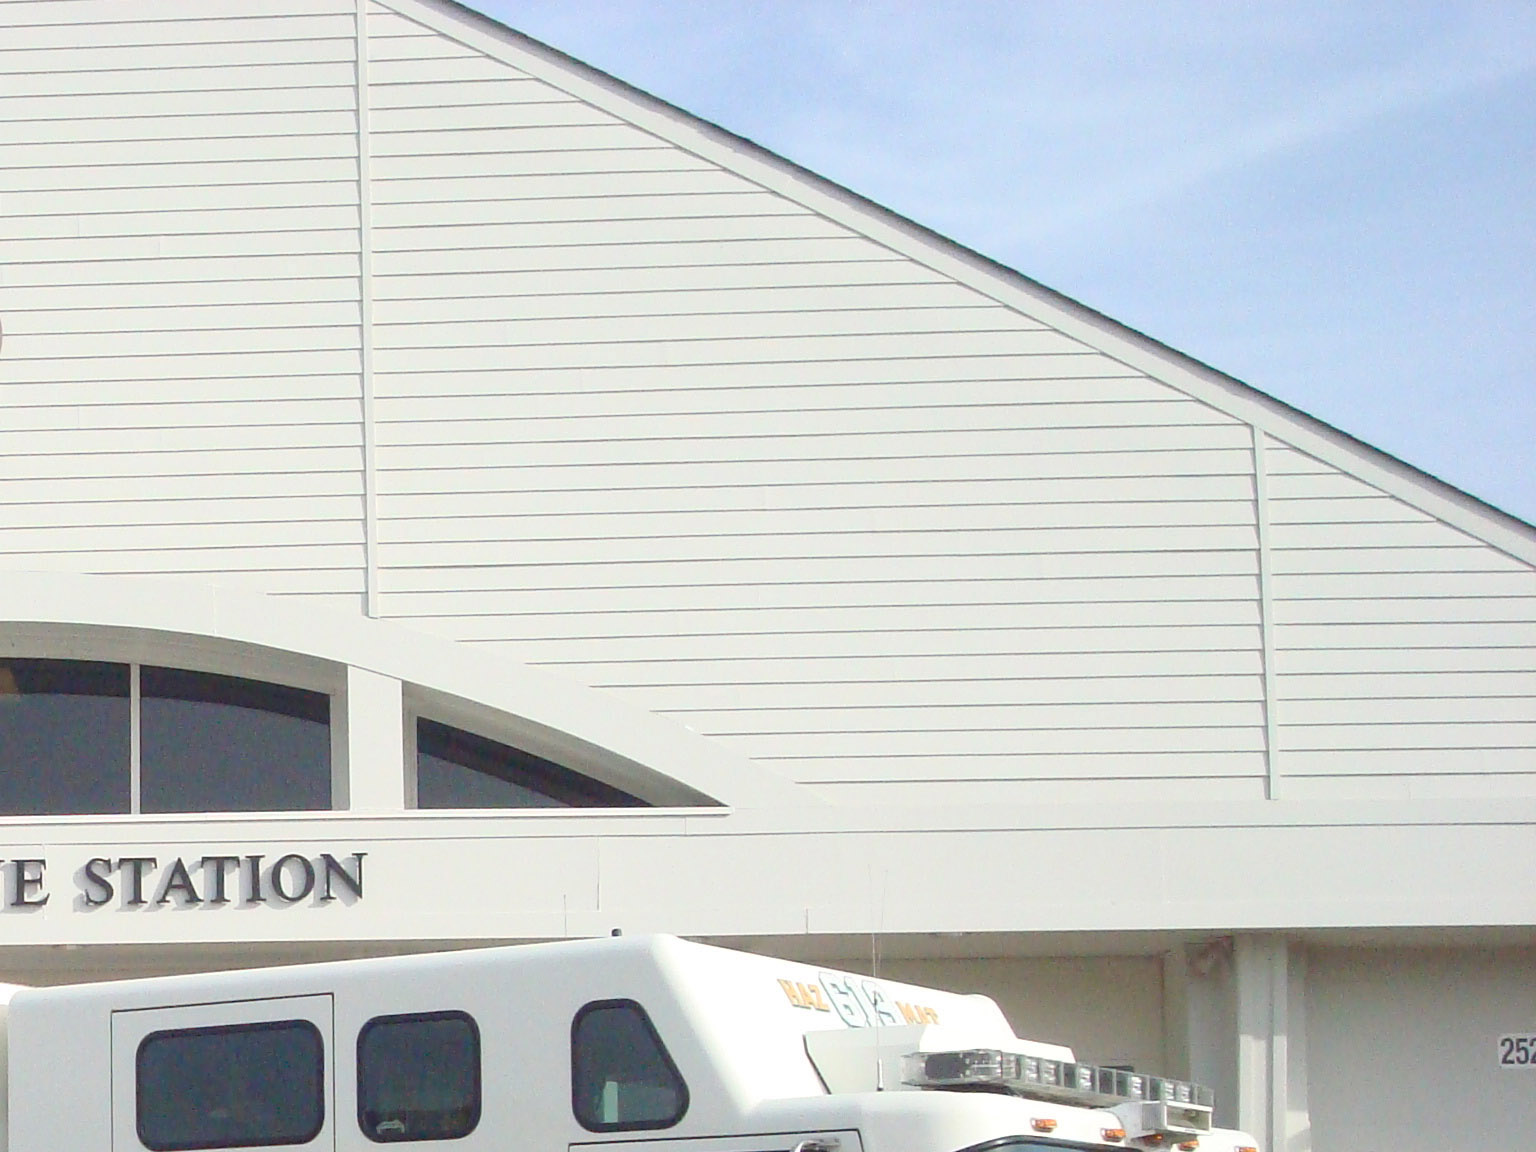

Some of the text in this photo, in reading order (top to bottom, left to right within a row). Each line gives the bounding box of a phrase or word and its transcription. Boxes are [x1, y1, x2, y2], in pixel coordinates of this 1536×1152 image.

[85, 853, 368, 905] STATION
[777, 979, 830, 1012] HAZ
[895, 1000, 941, 1025] MAT
